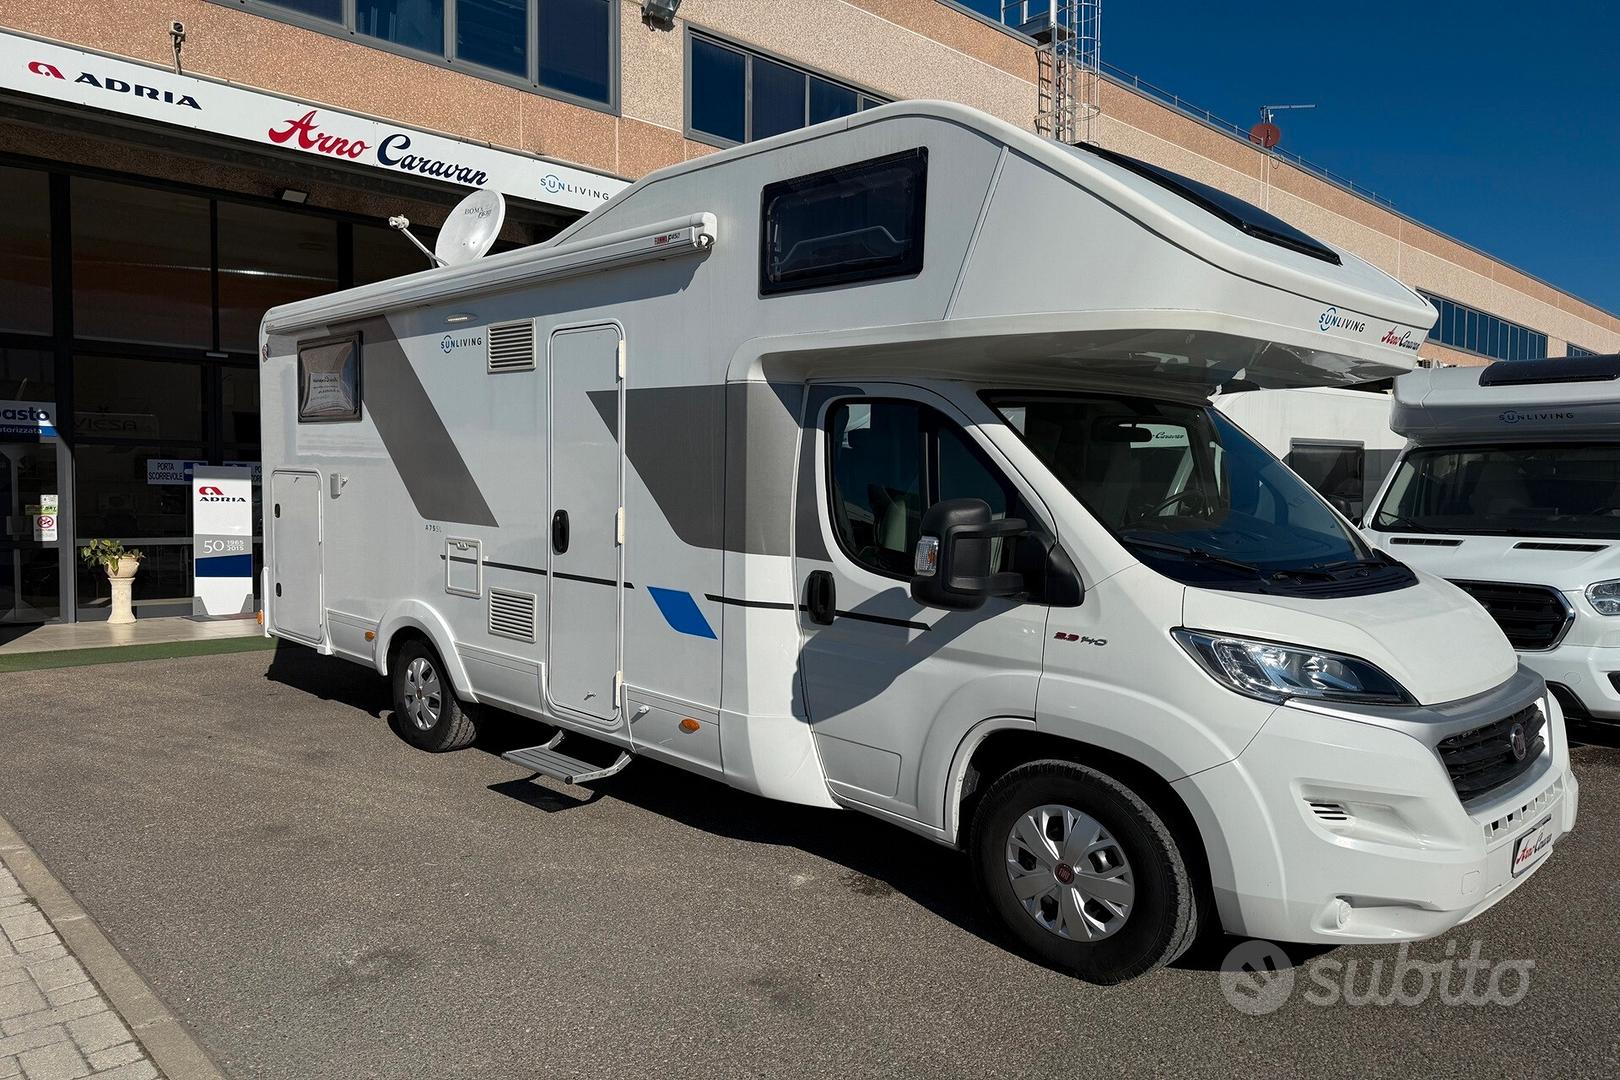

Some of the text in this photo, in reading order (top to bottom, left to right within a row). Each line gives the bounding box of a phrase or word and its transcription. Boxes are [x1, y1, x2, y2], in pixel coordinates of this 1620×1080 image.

[74, 71, 203, 111] ADRIA
[268, 109, 489, 186] Arno Caravan
[540, 175, 610, 201] SUNLIVING
[1318, 308, 1366, 333] SUNLIVING
[440, 336, 482, 351] SUNLIVING
[0, 406, 49, 421] asto
[1498, 411, 1575, 422] SUNLIVING
[157, 462, 175, 471] PORTA
[148, 471, 184, 481] SCORREVOLE
[202, 539, 225, 554] 50
